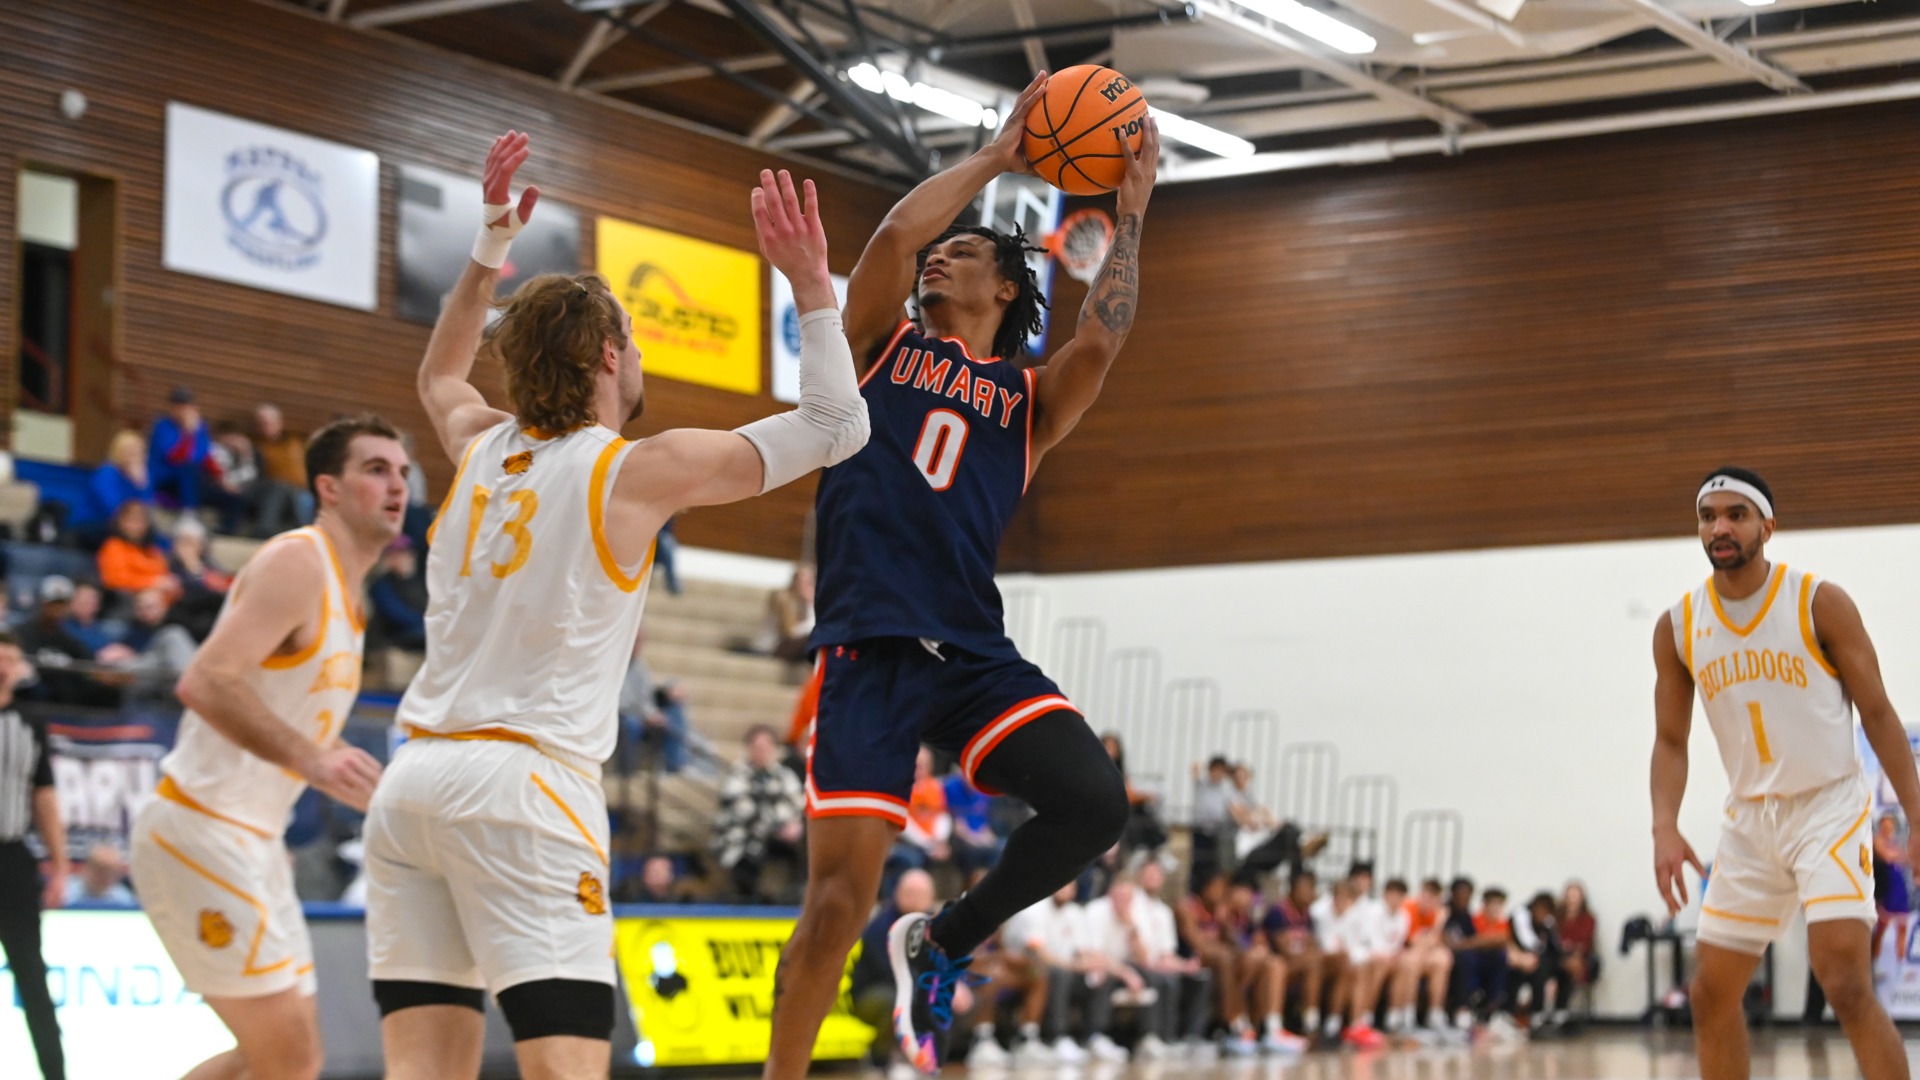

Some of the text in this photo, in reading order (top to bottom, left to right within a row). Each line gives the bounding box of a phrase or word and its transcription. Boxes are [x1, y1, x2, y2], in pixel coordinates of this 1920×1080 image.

[1099, 75, 1134, 103] CAA
[890, 346, 1023, 429] UMARY
[911, 407, 970, 492] 0
[458, 483, 539, 580] 13
[1698, 648, 1808, 701] BULLDOGS
[1746, 701, 1773, 763] 1
